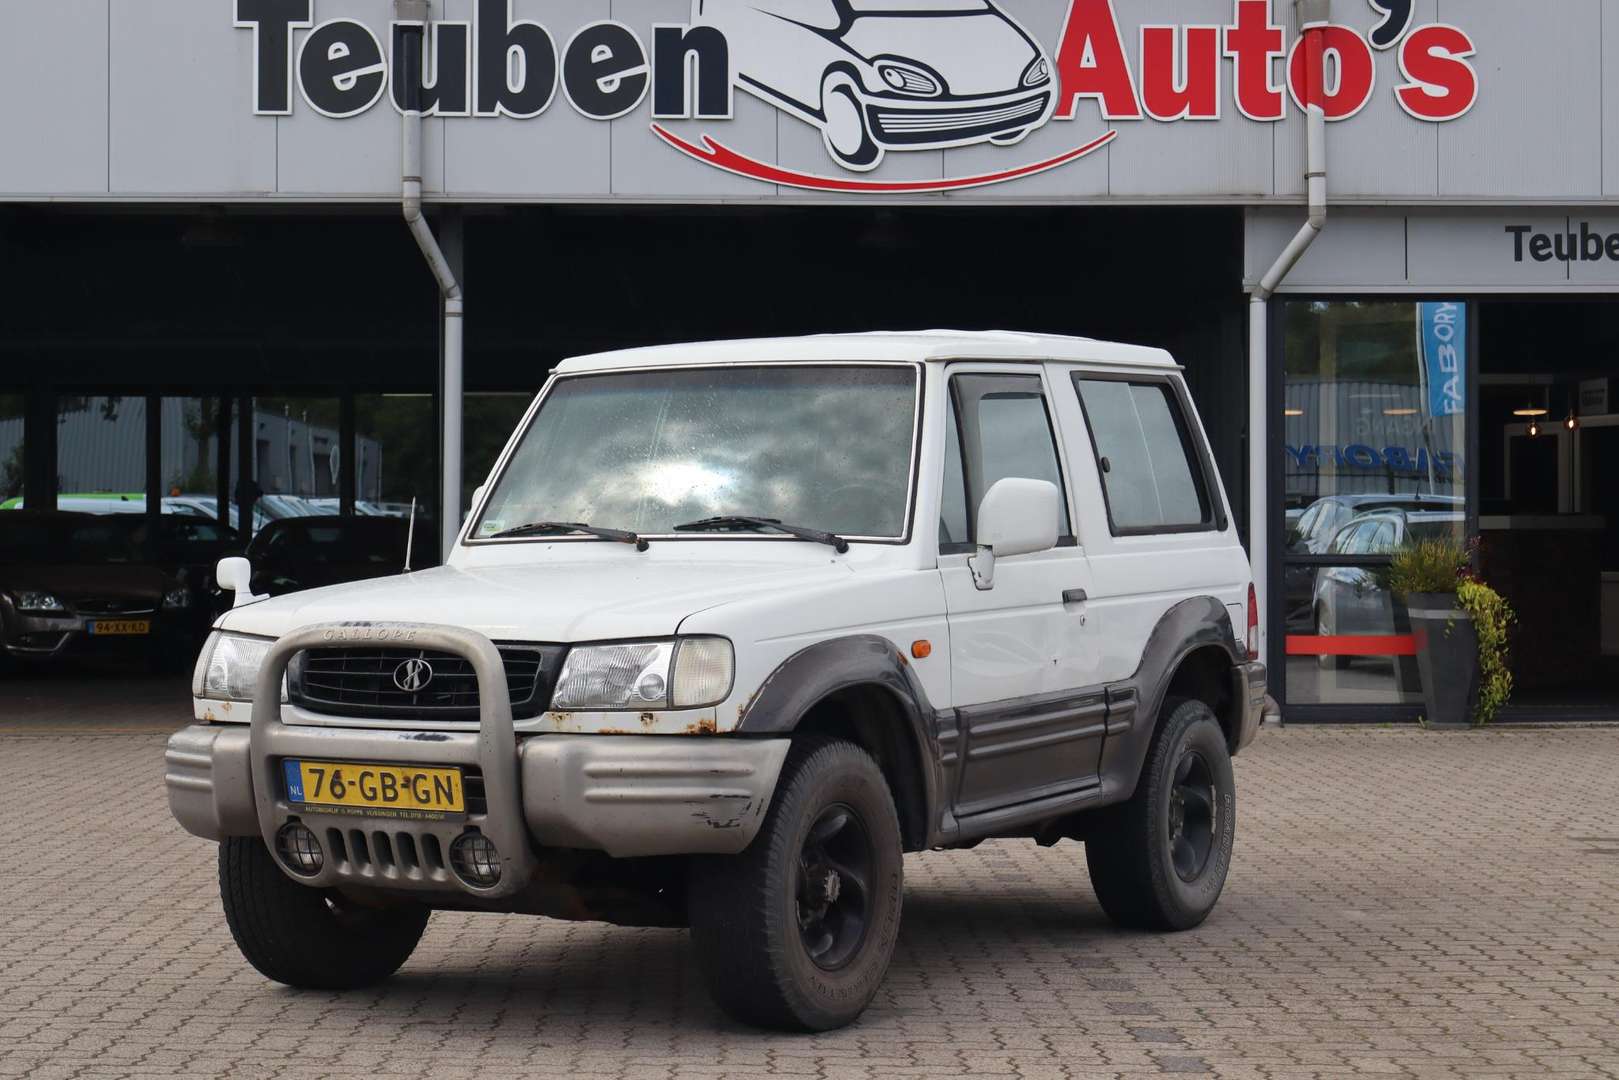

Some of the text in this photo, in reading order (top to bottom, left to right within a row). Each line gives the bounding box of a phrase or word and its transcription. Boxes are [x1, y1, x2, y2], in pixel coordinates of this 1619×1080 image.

[235, 0, 1477, 120] Teuben Auto's
[1433, 302, 1463, 414] FABORY
[289, 768, 455, 805] NL 76-GB-GN
